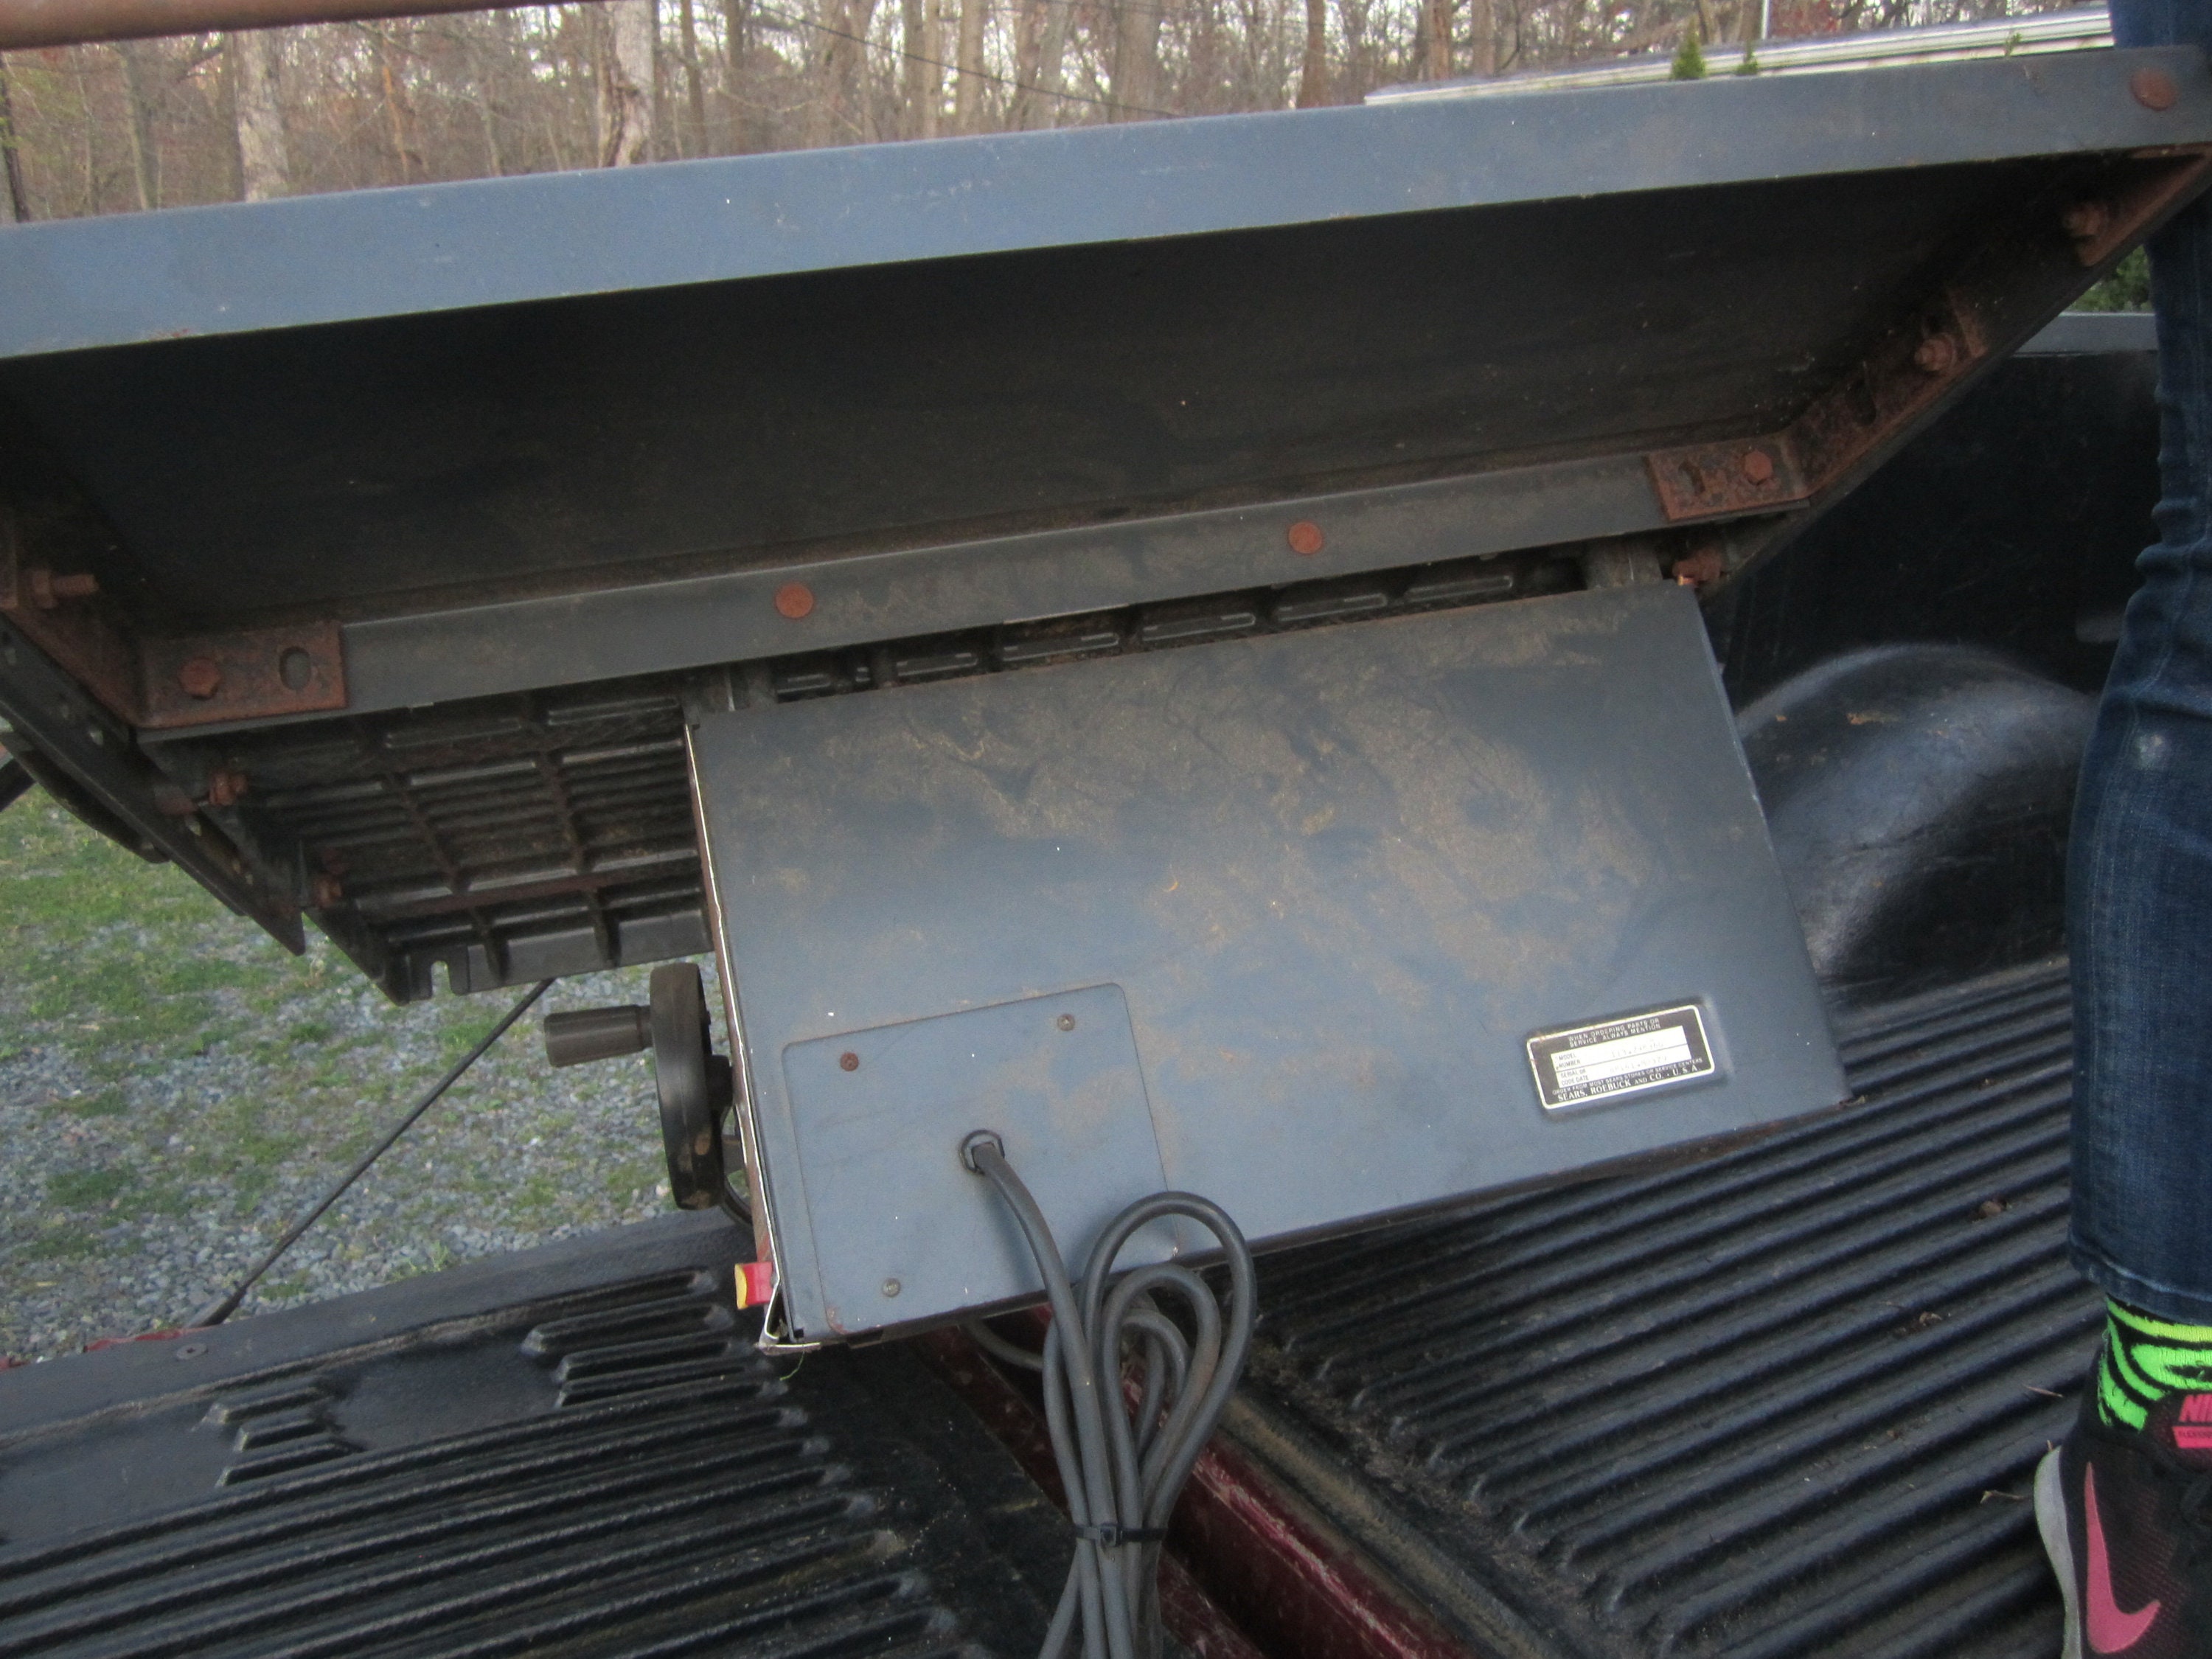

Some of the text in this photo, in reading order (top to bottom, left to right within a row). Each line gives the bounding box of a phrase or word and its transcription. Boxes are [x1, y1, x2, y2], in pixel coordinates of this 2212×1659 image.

[1568, 1033, 1588, 1041] WHEN
[1590, 1025, 1625, 1037] ORDERING
[1628, 1020, 1648, 1029] PARTS
[1569, 1023, 1661, 1048] SERVICE ALWAYS MENTION
[1559, 1059, 1581, 1068] NUMBER
[1560, 1070, 1578, 1078] SERIAL
[1552, 1088, 1571, 1096] ORDER
[1572, 1082, 1587, 1091] FROM
[1605, 1076, 1623, 1084] SEARS
[1624, 1071, 1645, 1079] STORES
[1655, 1063, 1677, 1072] SERVICE
[1678, 1057, 1703, 1068] CENTERS
[1590, 1079, 1632, 1095] ROEBUCK
[1649, 1073, 1664, 1082] CO.
